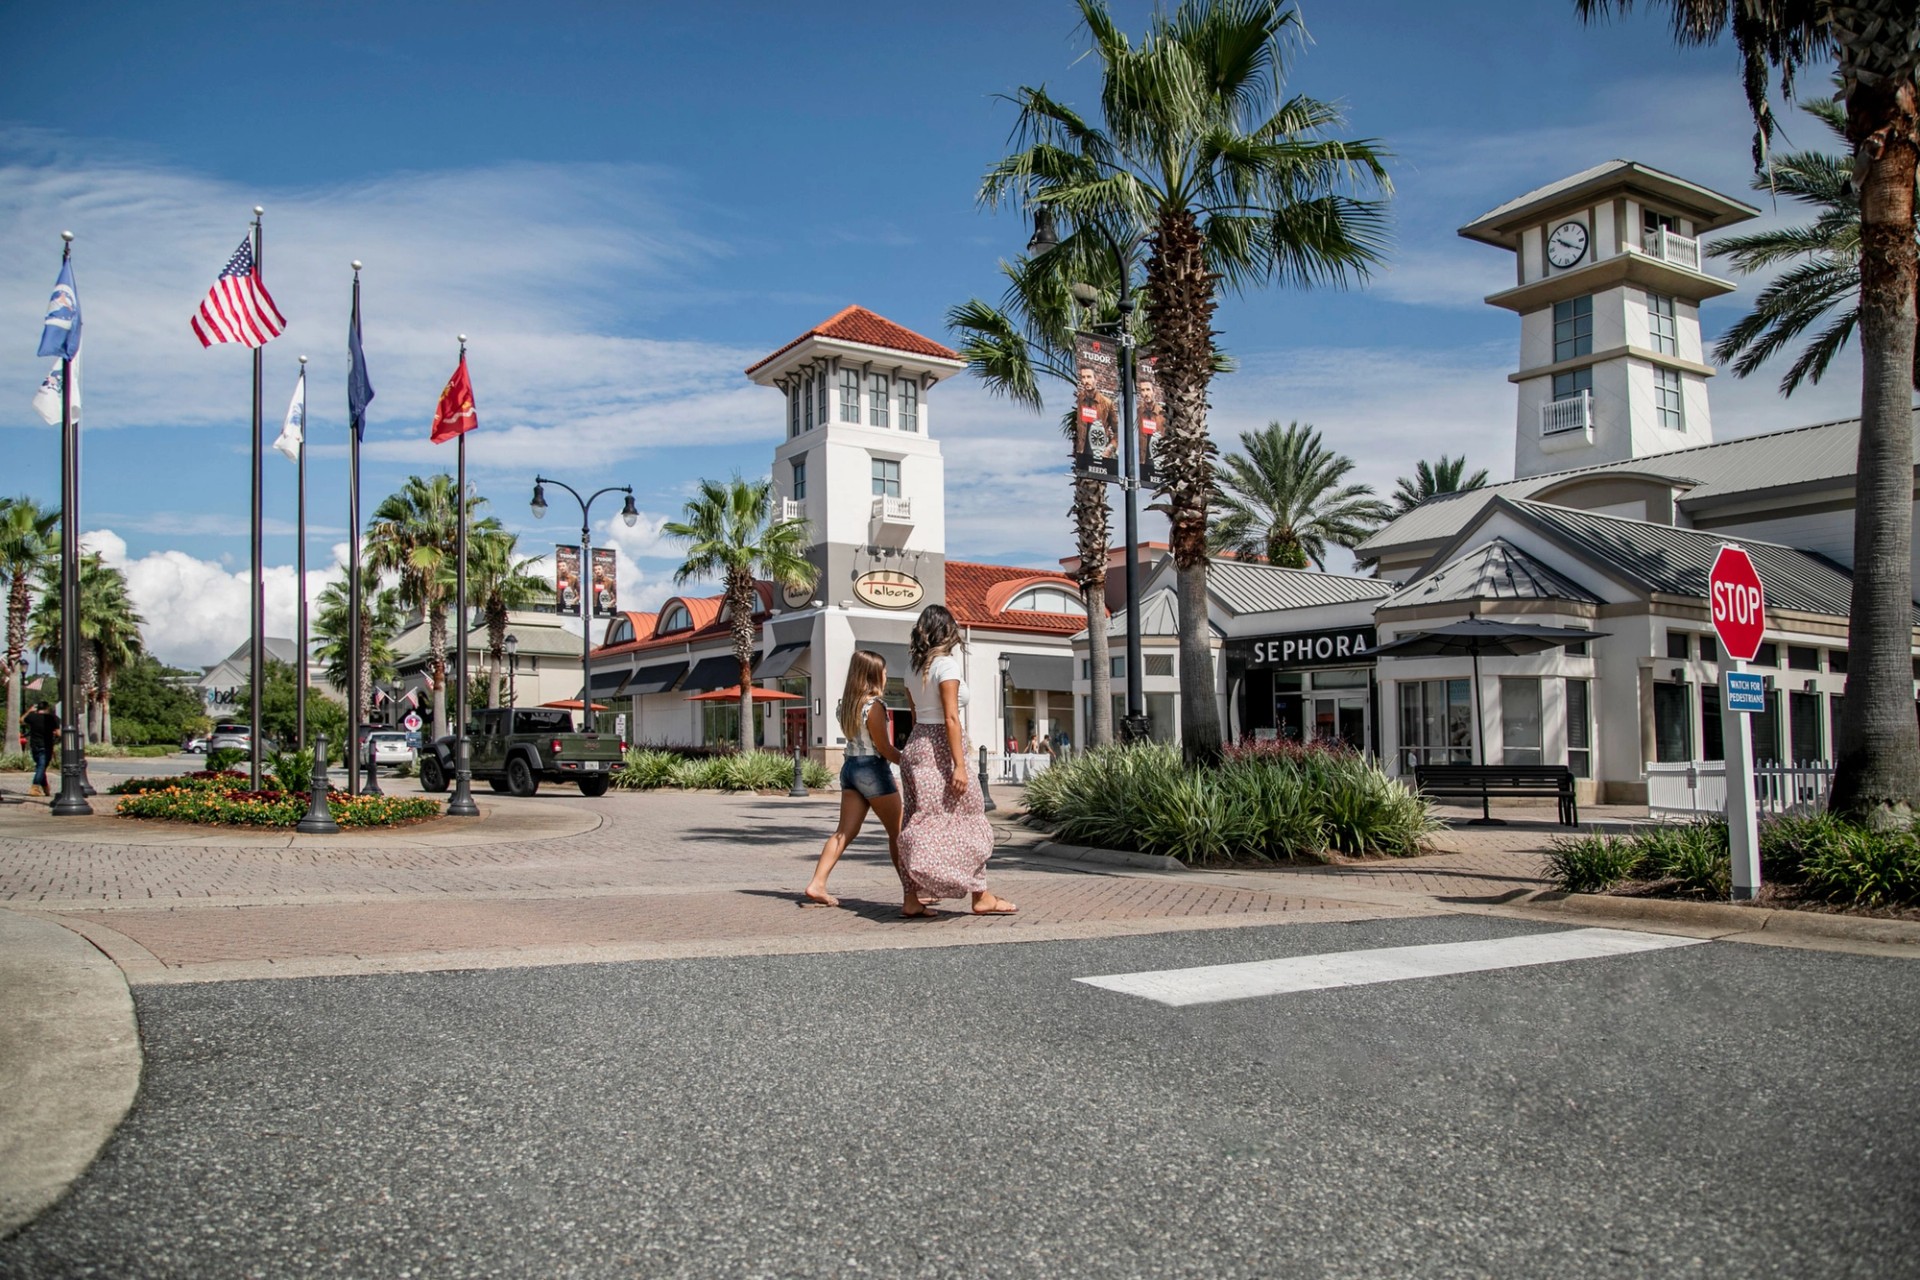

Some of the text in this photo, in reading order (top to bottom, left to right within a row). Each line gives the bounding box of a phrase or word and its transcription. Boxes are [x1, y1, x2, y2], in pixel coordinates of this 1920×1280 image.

[1082, 351, 1111, 364] TUDOR
[1088, 465, 1108, 475] REEDS
[863, 581, 916, 598] Talbots
[1714, 580, 1760, 625] STOP
[1254, 634, 1367, 663] SEPHORA
[1730, 680, 1761, 691] WATCH FOR
[1729, 692, 1764, 704] PEDESTRIANS
